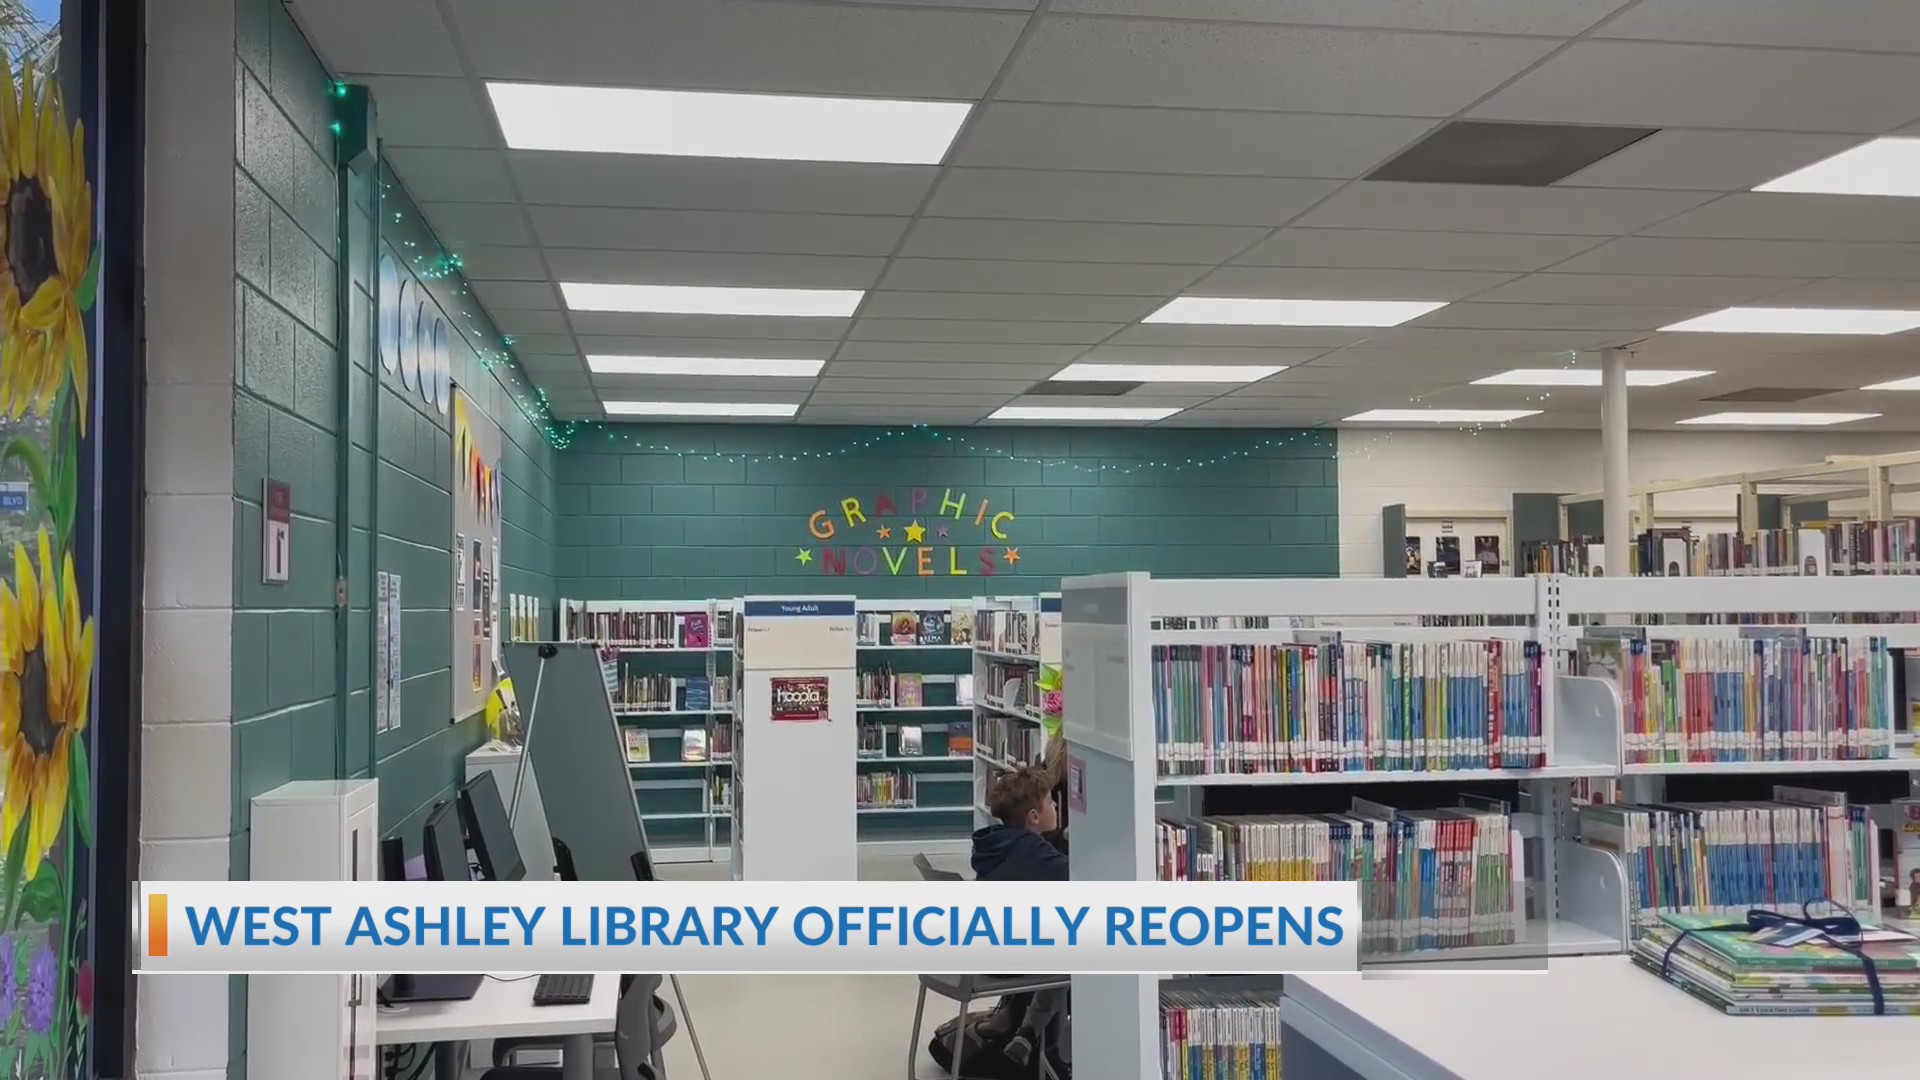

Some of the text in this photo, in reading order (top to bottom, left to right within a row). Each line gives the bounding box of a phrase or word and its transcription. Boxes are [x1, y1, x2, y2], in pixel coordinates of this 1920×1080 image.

[809, 487, 1015, 540] GRAPHIC
[822, 546, 997, 577] NOVELS
[781, 603, 819, 613] Young Adult
[777, 687, 820, 705] hoopla
